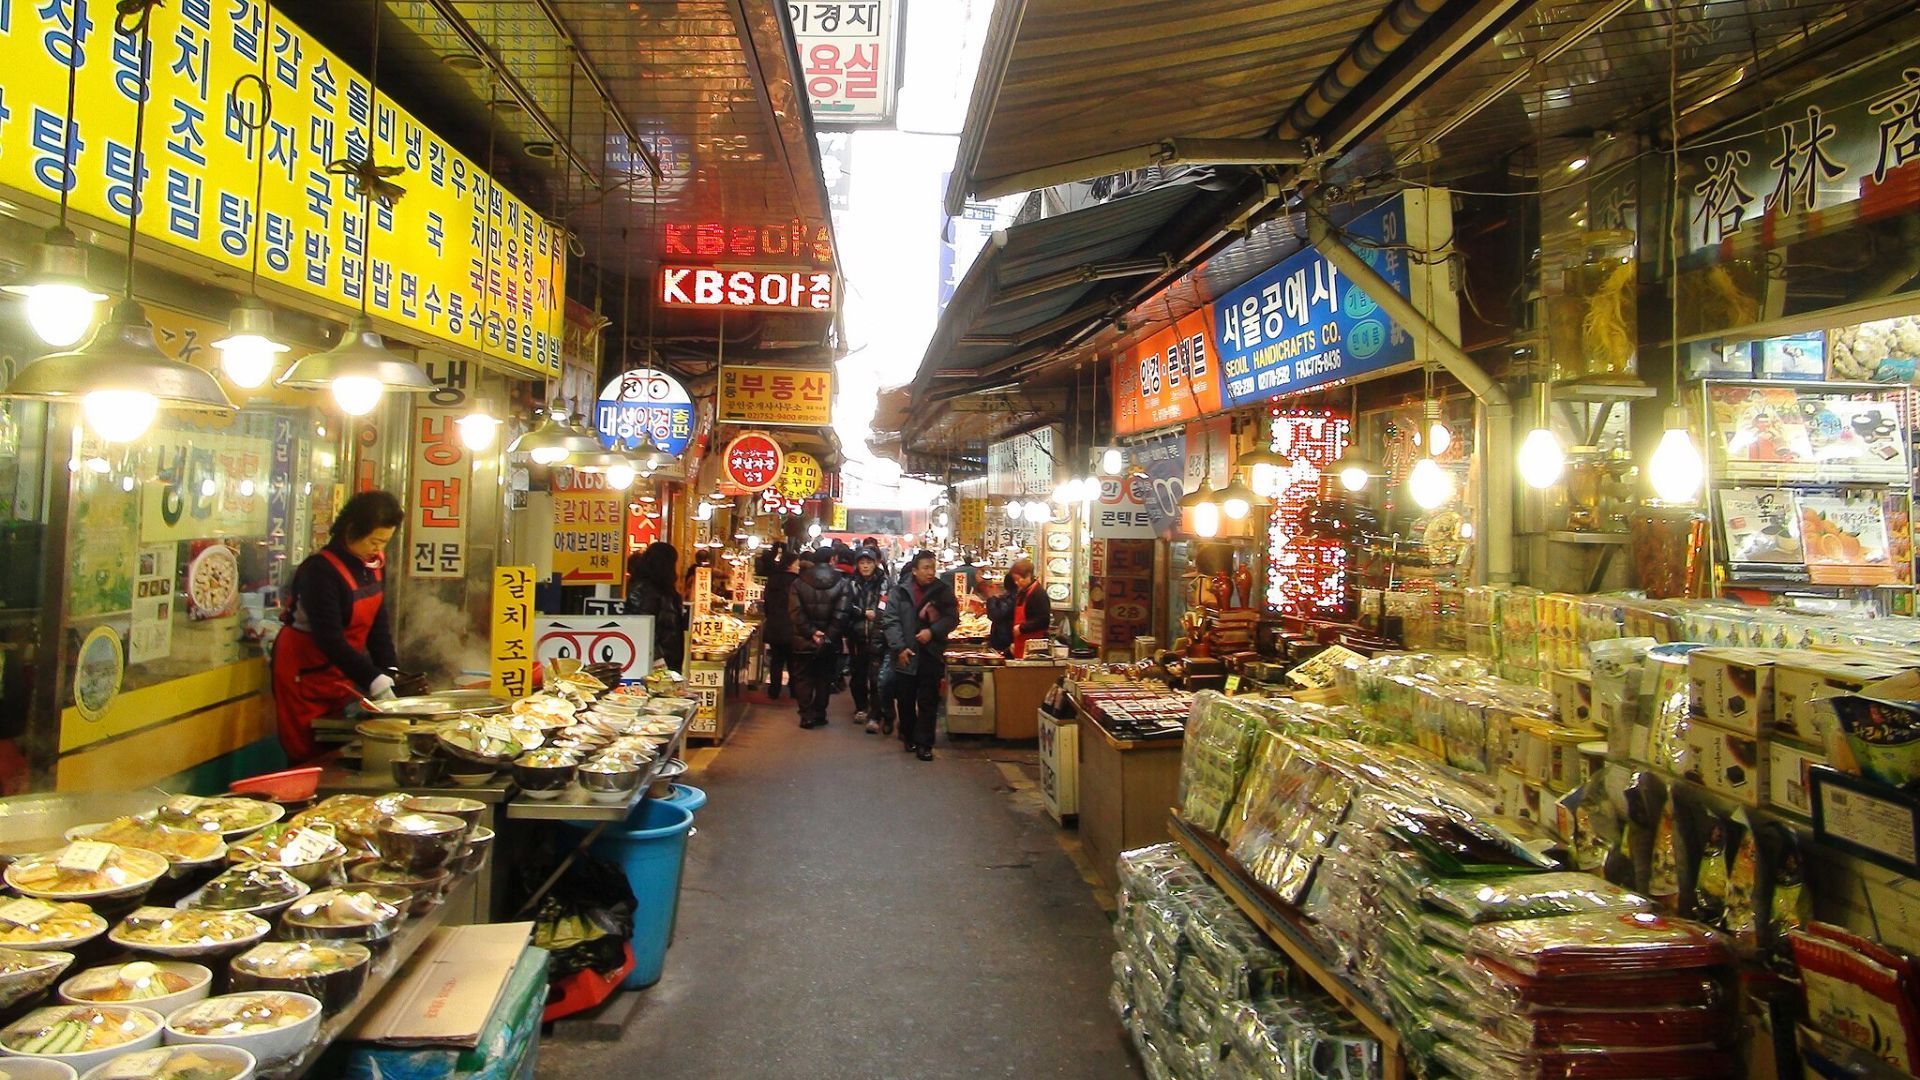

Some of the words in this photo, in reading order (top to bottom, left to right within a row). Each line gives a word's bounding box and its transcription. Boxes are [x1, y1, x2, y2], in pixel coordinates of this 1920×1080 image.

[797, 43, 880, 99] 용실
[218, 0, 263, 257] 갈비탕
[264, 24, 302, 272] 감자탕
[305, 57, 337, 286] 순대국밥
[400, 121, 422, 319] 냉면
[423, 140, 446, 326] 칼국수
[447, 158, 467, 335] 우동
[468, 172, 486, 341] 잔치국수
[536, 221, 549, 364] 삼계탕
[1223, 258, 1338, 351] 서울공예사
[739, 374, 826, 401] 부동산
[1225, 354, 1250, 378] SEOUL
[1253, 329, 1316, 370] HANDICRAFTS
[1321, 320, 1342, 345] CO.
[563, 499, 620, 525] 갈치조림
[573, 470, 613, 490] KBS
[1101, 511, 1149, 527] 콘택트
[415, 542, 462, 572] 전문
[590, 555, 610, 569] 지하
[496, 570, 532, 697] 갈치조림
